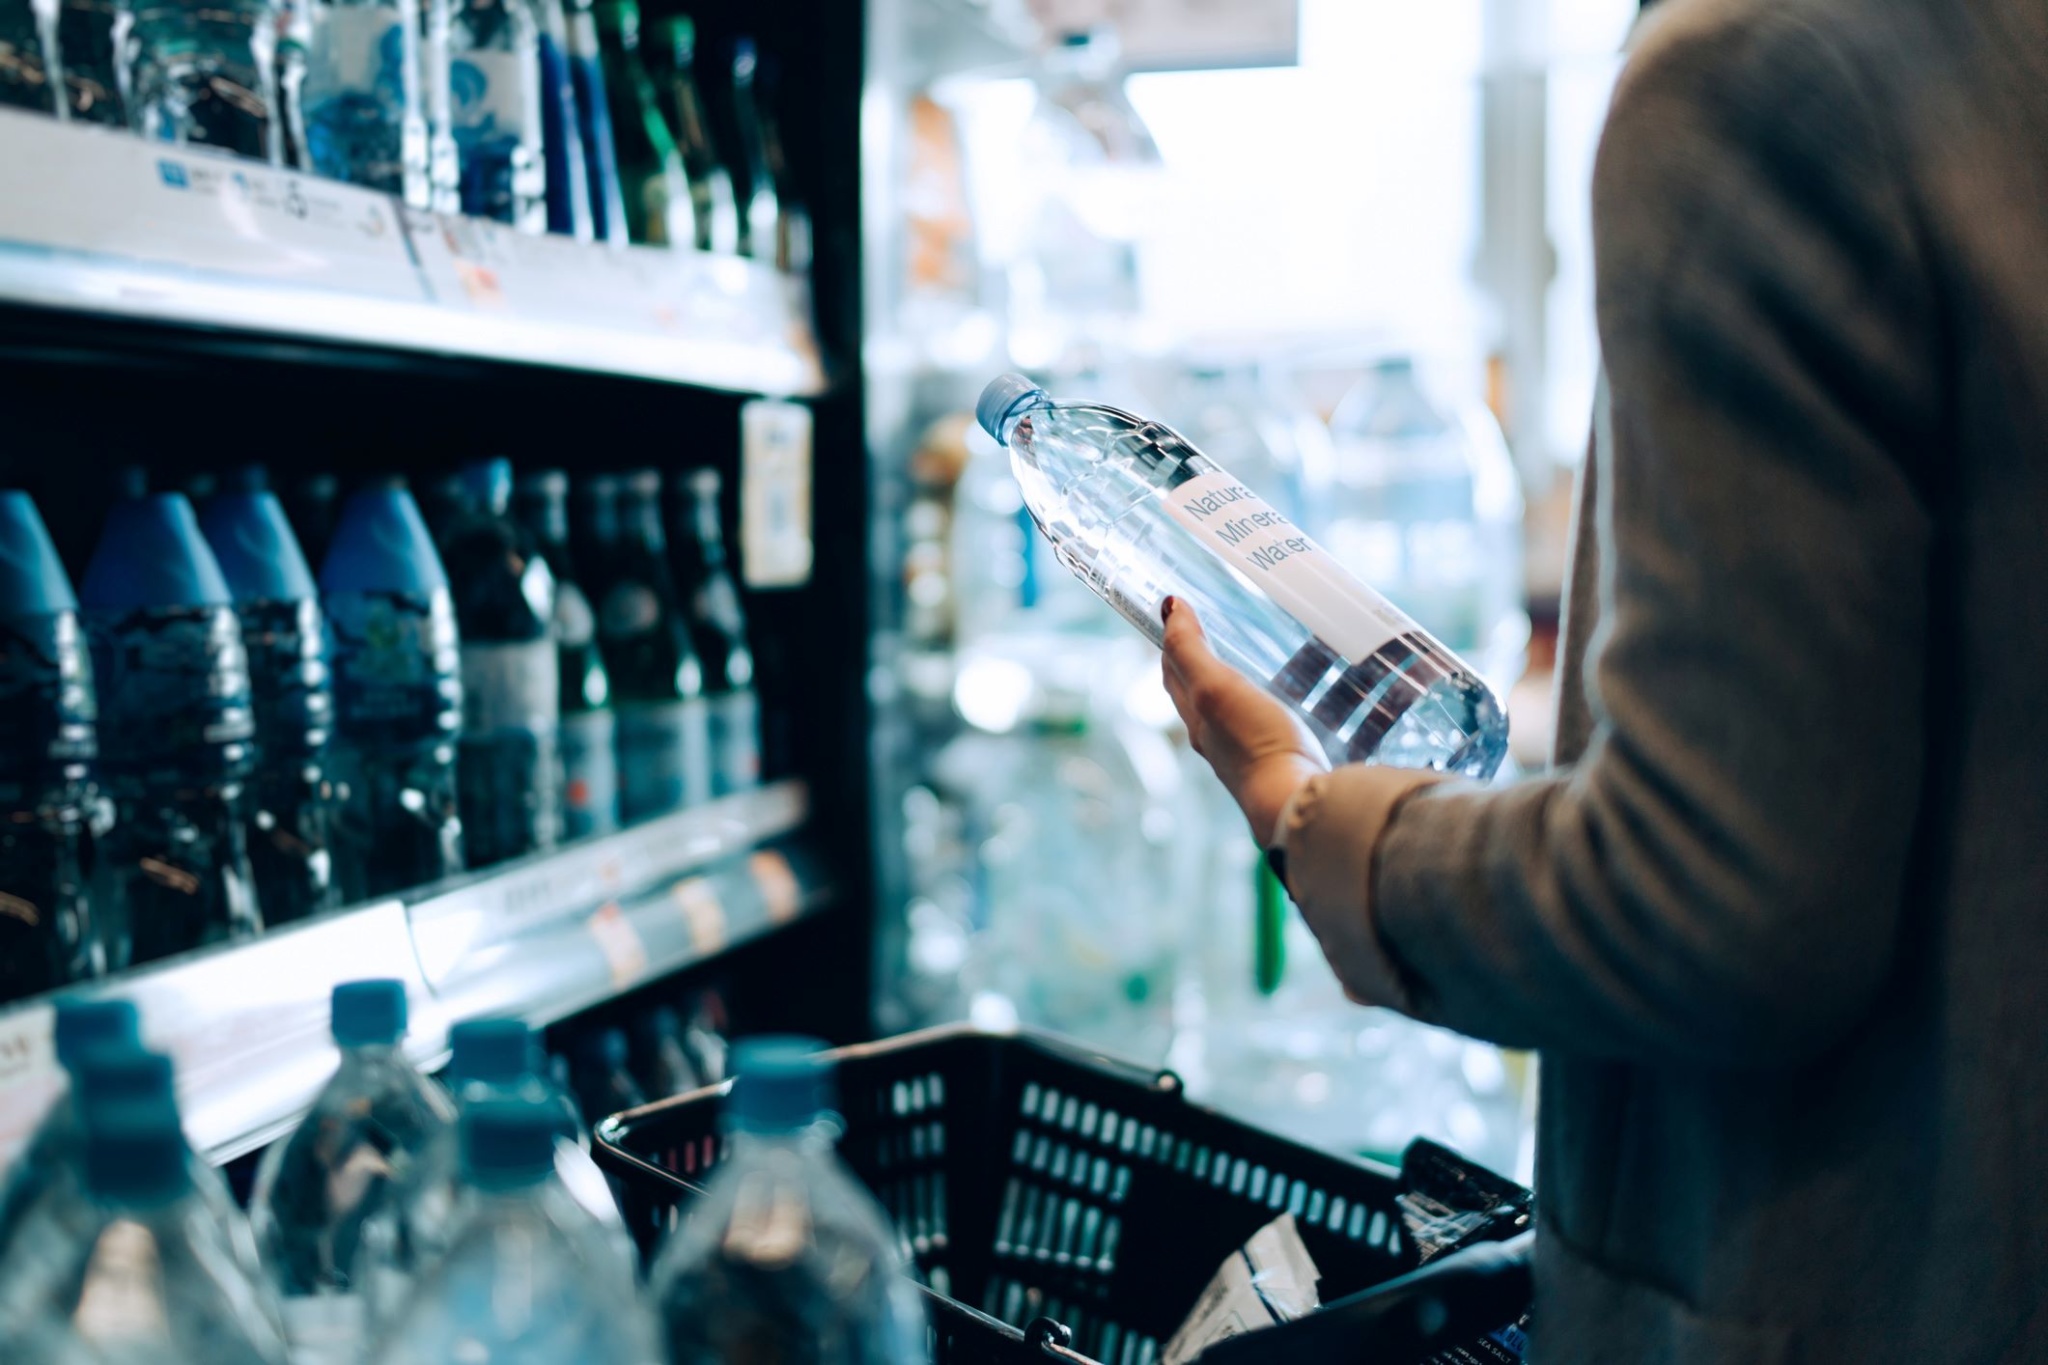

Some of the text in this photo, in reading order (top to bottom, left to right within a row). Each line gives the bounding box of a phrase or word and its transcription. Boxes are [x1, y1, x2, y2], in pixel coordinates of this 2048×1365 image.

[1246, 537, 1312, 572] Water
[1477, 1337, 1492, 1351] SEA
[1491, 1346, 1512, 1364] SALT
